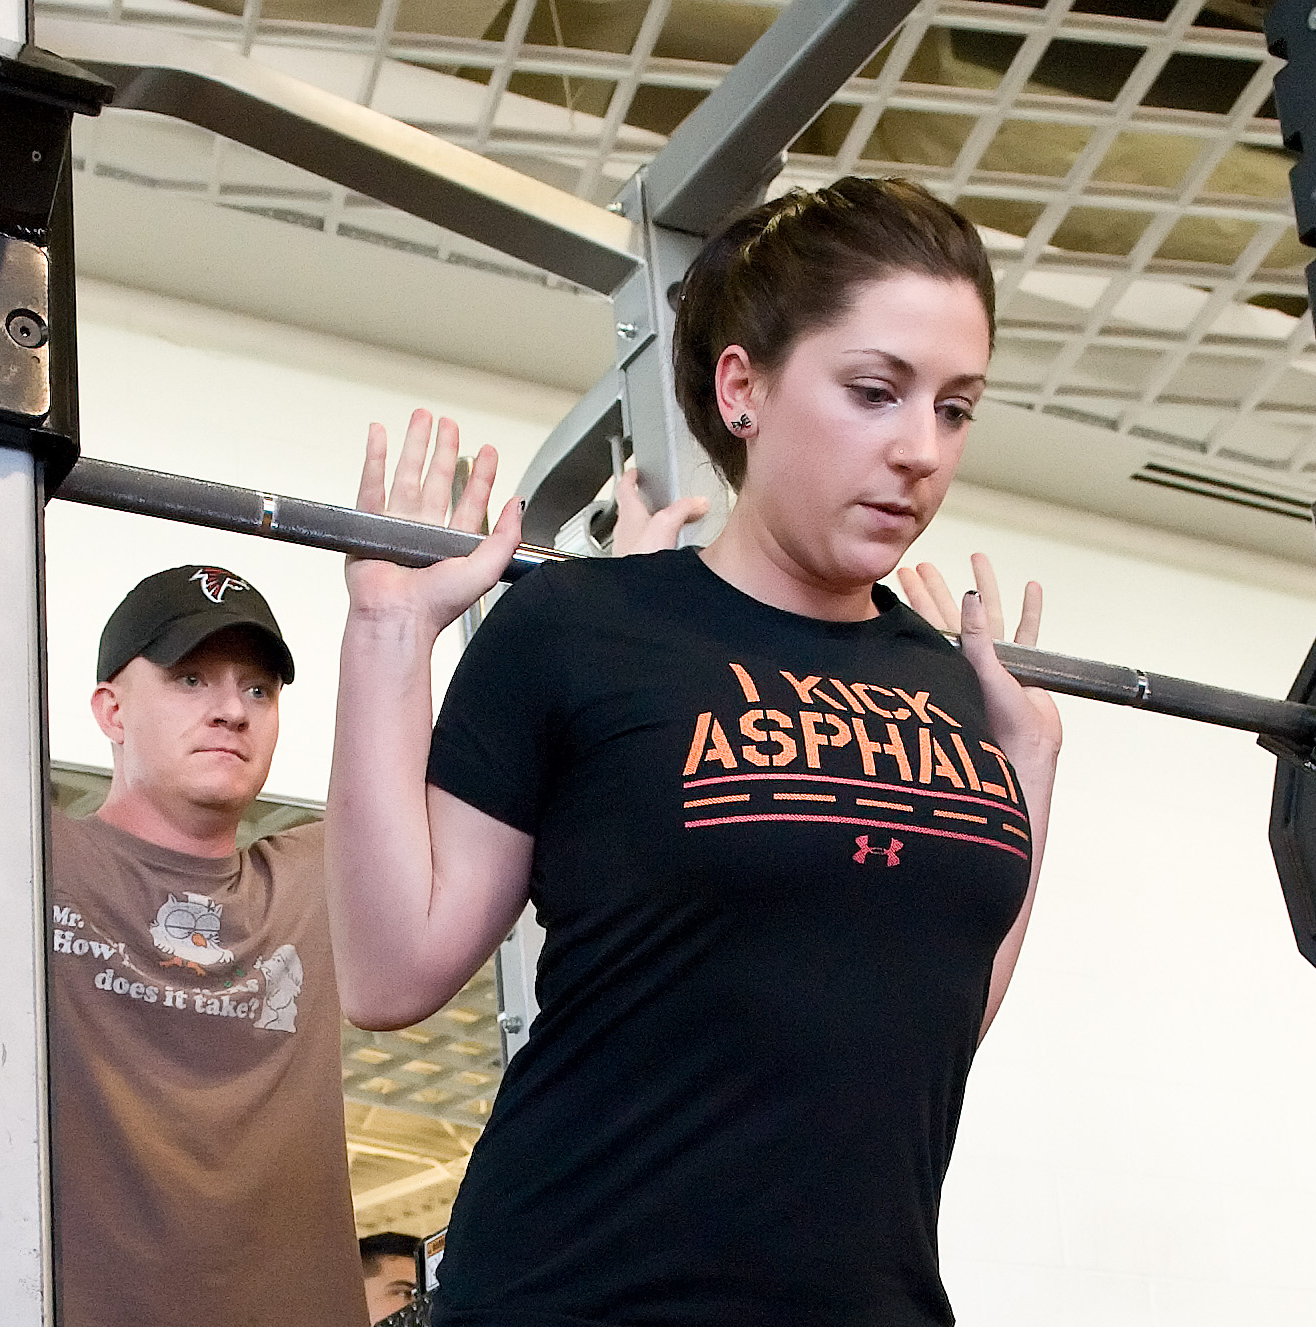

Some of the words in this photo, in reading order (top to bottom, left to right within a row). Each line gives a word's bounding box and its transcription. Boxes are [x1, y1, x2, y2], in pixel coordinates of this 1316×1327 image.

[729, 662, 760, 702] I
[779, 669, 963, 729] KICK
[682, 708, 1019, 804] ASPHALT
[52, 904, 85, 928] Mr.
[52, 928, 117, 961] How
[94, 968, 160, 1004] does
[163, 986, 189, 1010] it
[193, 994, 260, 1020] take?
